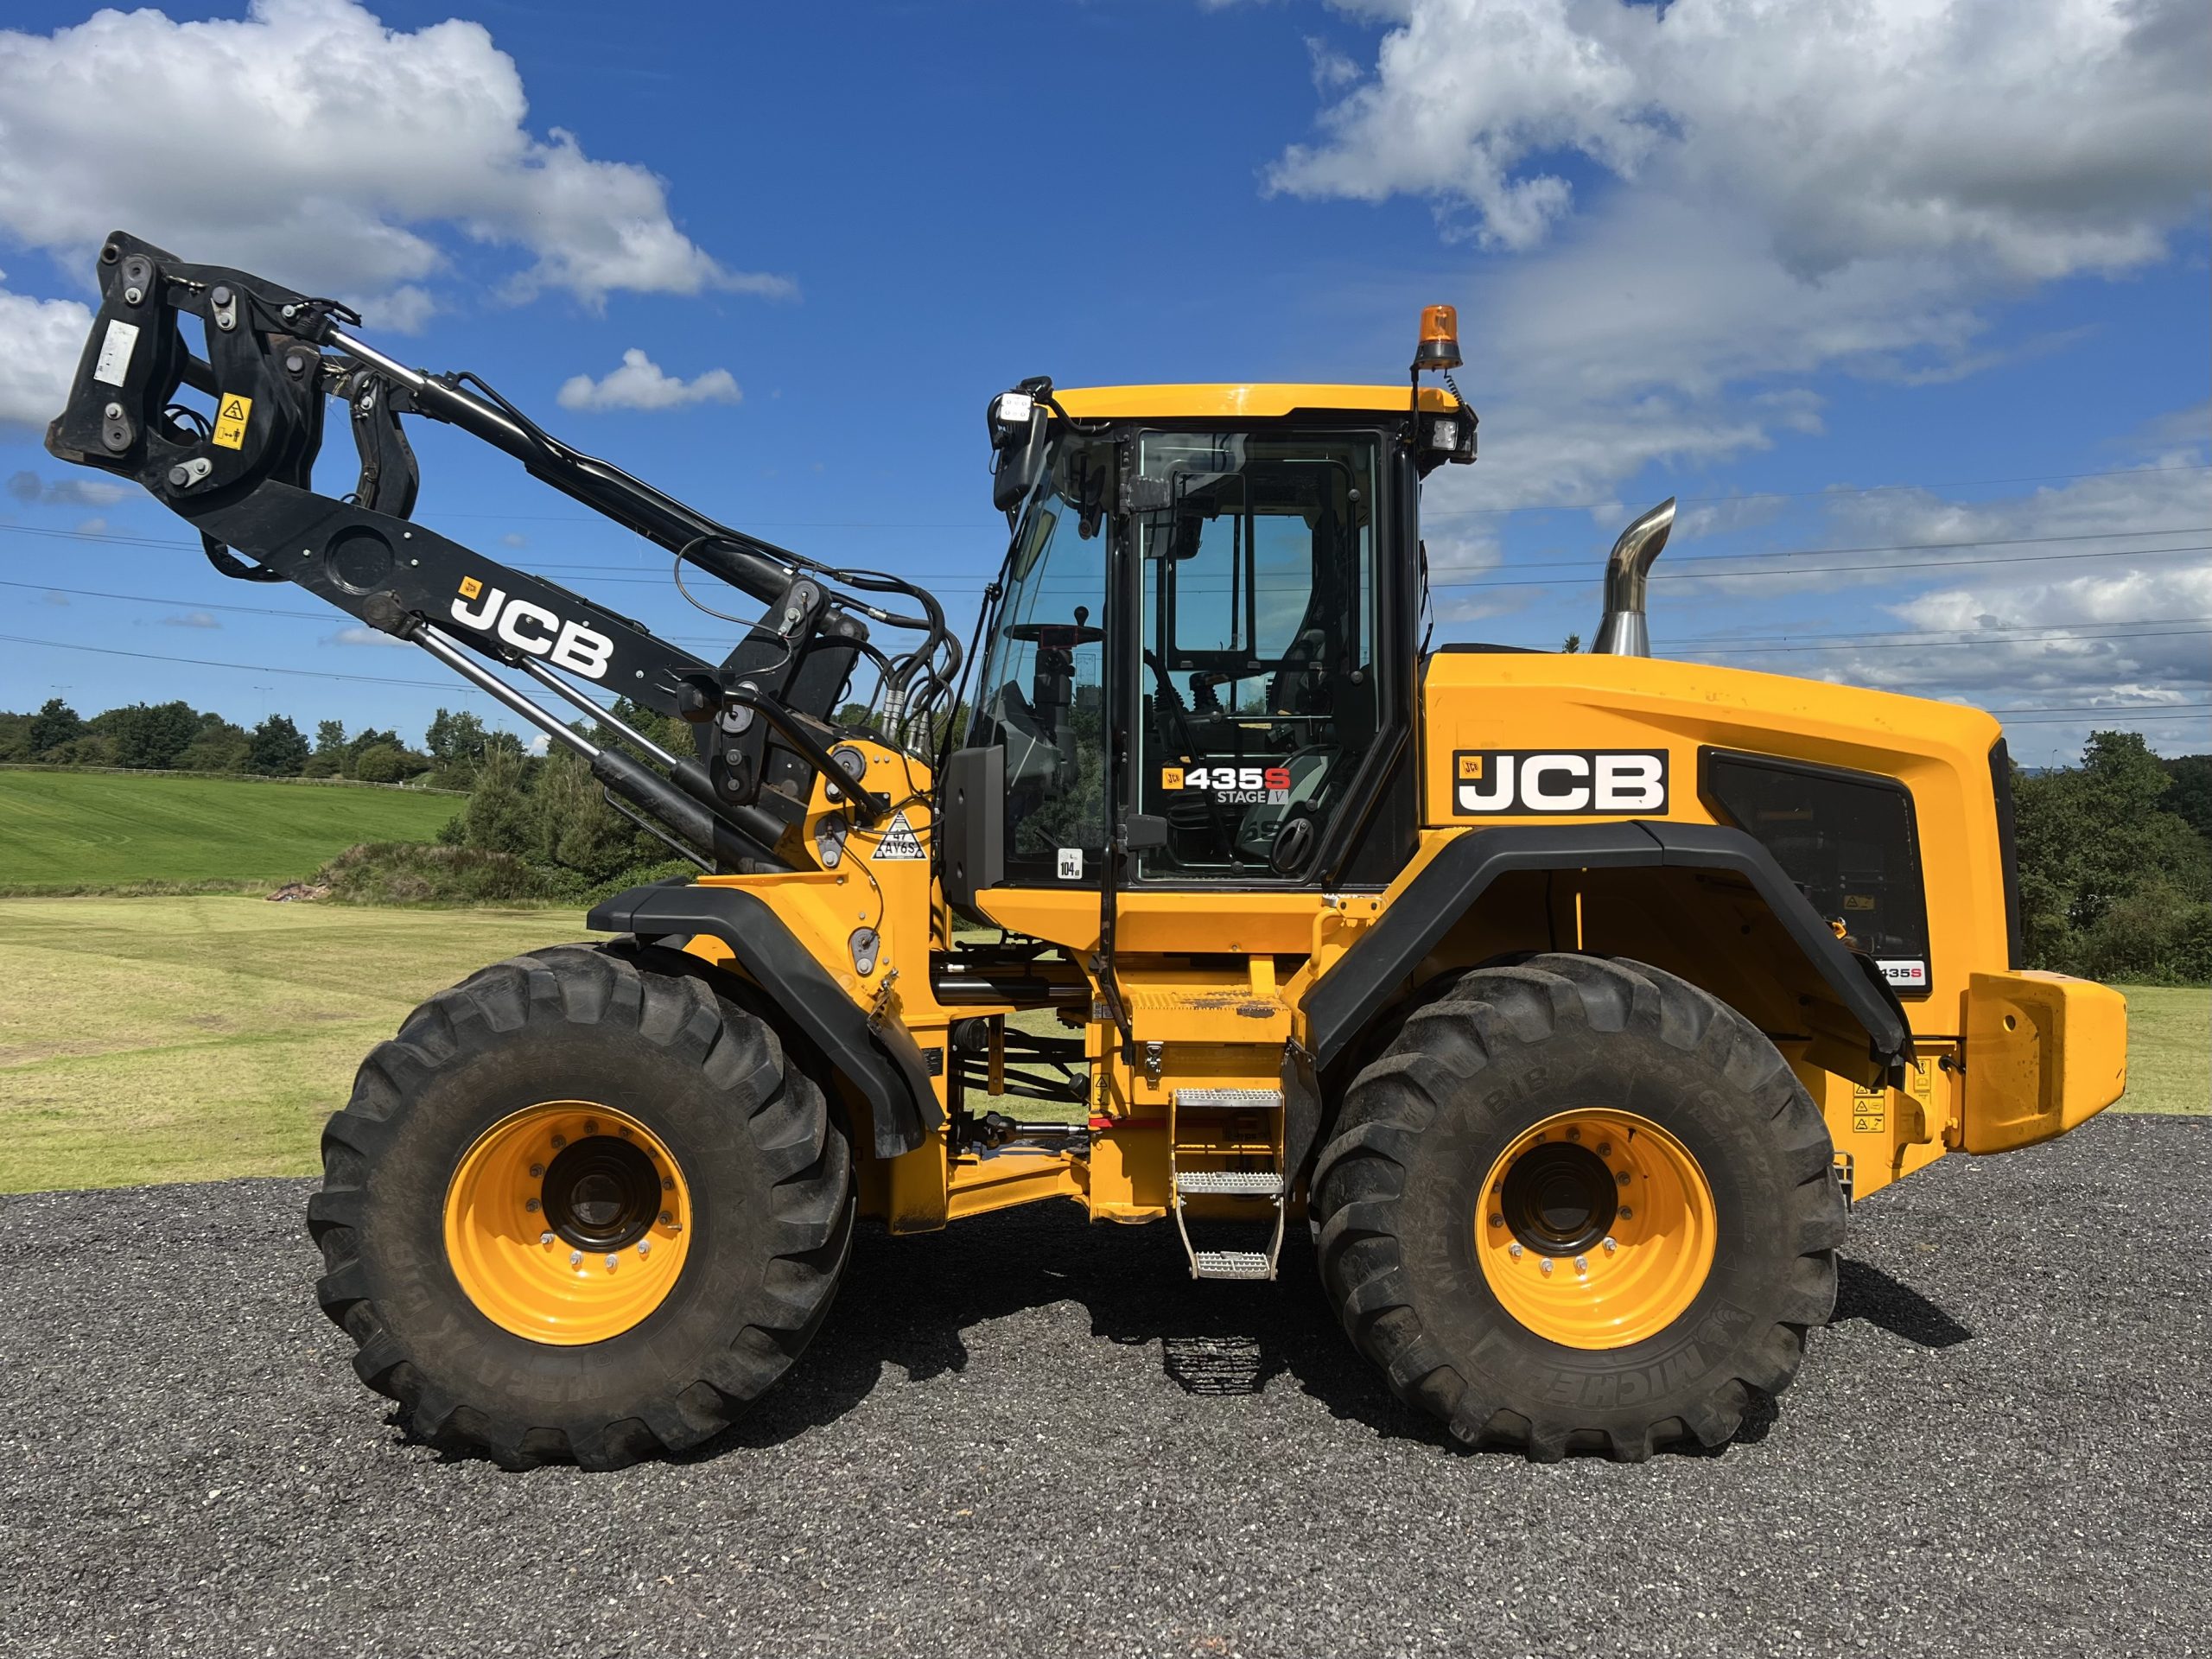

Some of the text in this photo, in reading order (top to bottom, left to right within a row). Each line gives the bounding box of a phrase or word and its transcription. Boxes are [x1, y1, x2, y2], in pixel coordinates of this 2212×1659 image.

[450, 588, 613, 678] JCB
[1185, 767, 1291, 790] 435S
[1459, 754, 1664, 810] JCB
[1465, 762, 1478, 773] JCB
[1217, 791, 1284, 803] STAGE V
[1061, 862, 1074, 876] 104
[1482, 1066, 1548, 1116] BIB
[1482, 1340, 1714, 1407] MICHE
